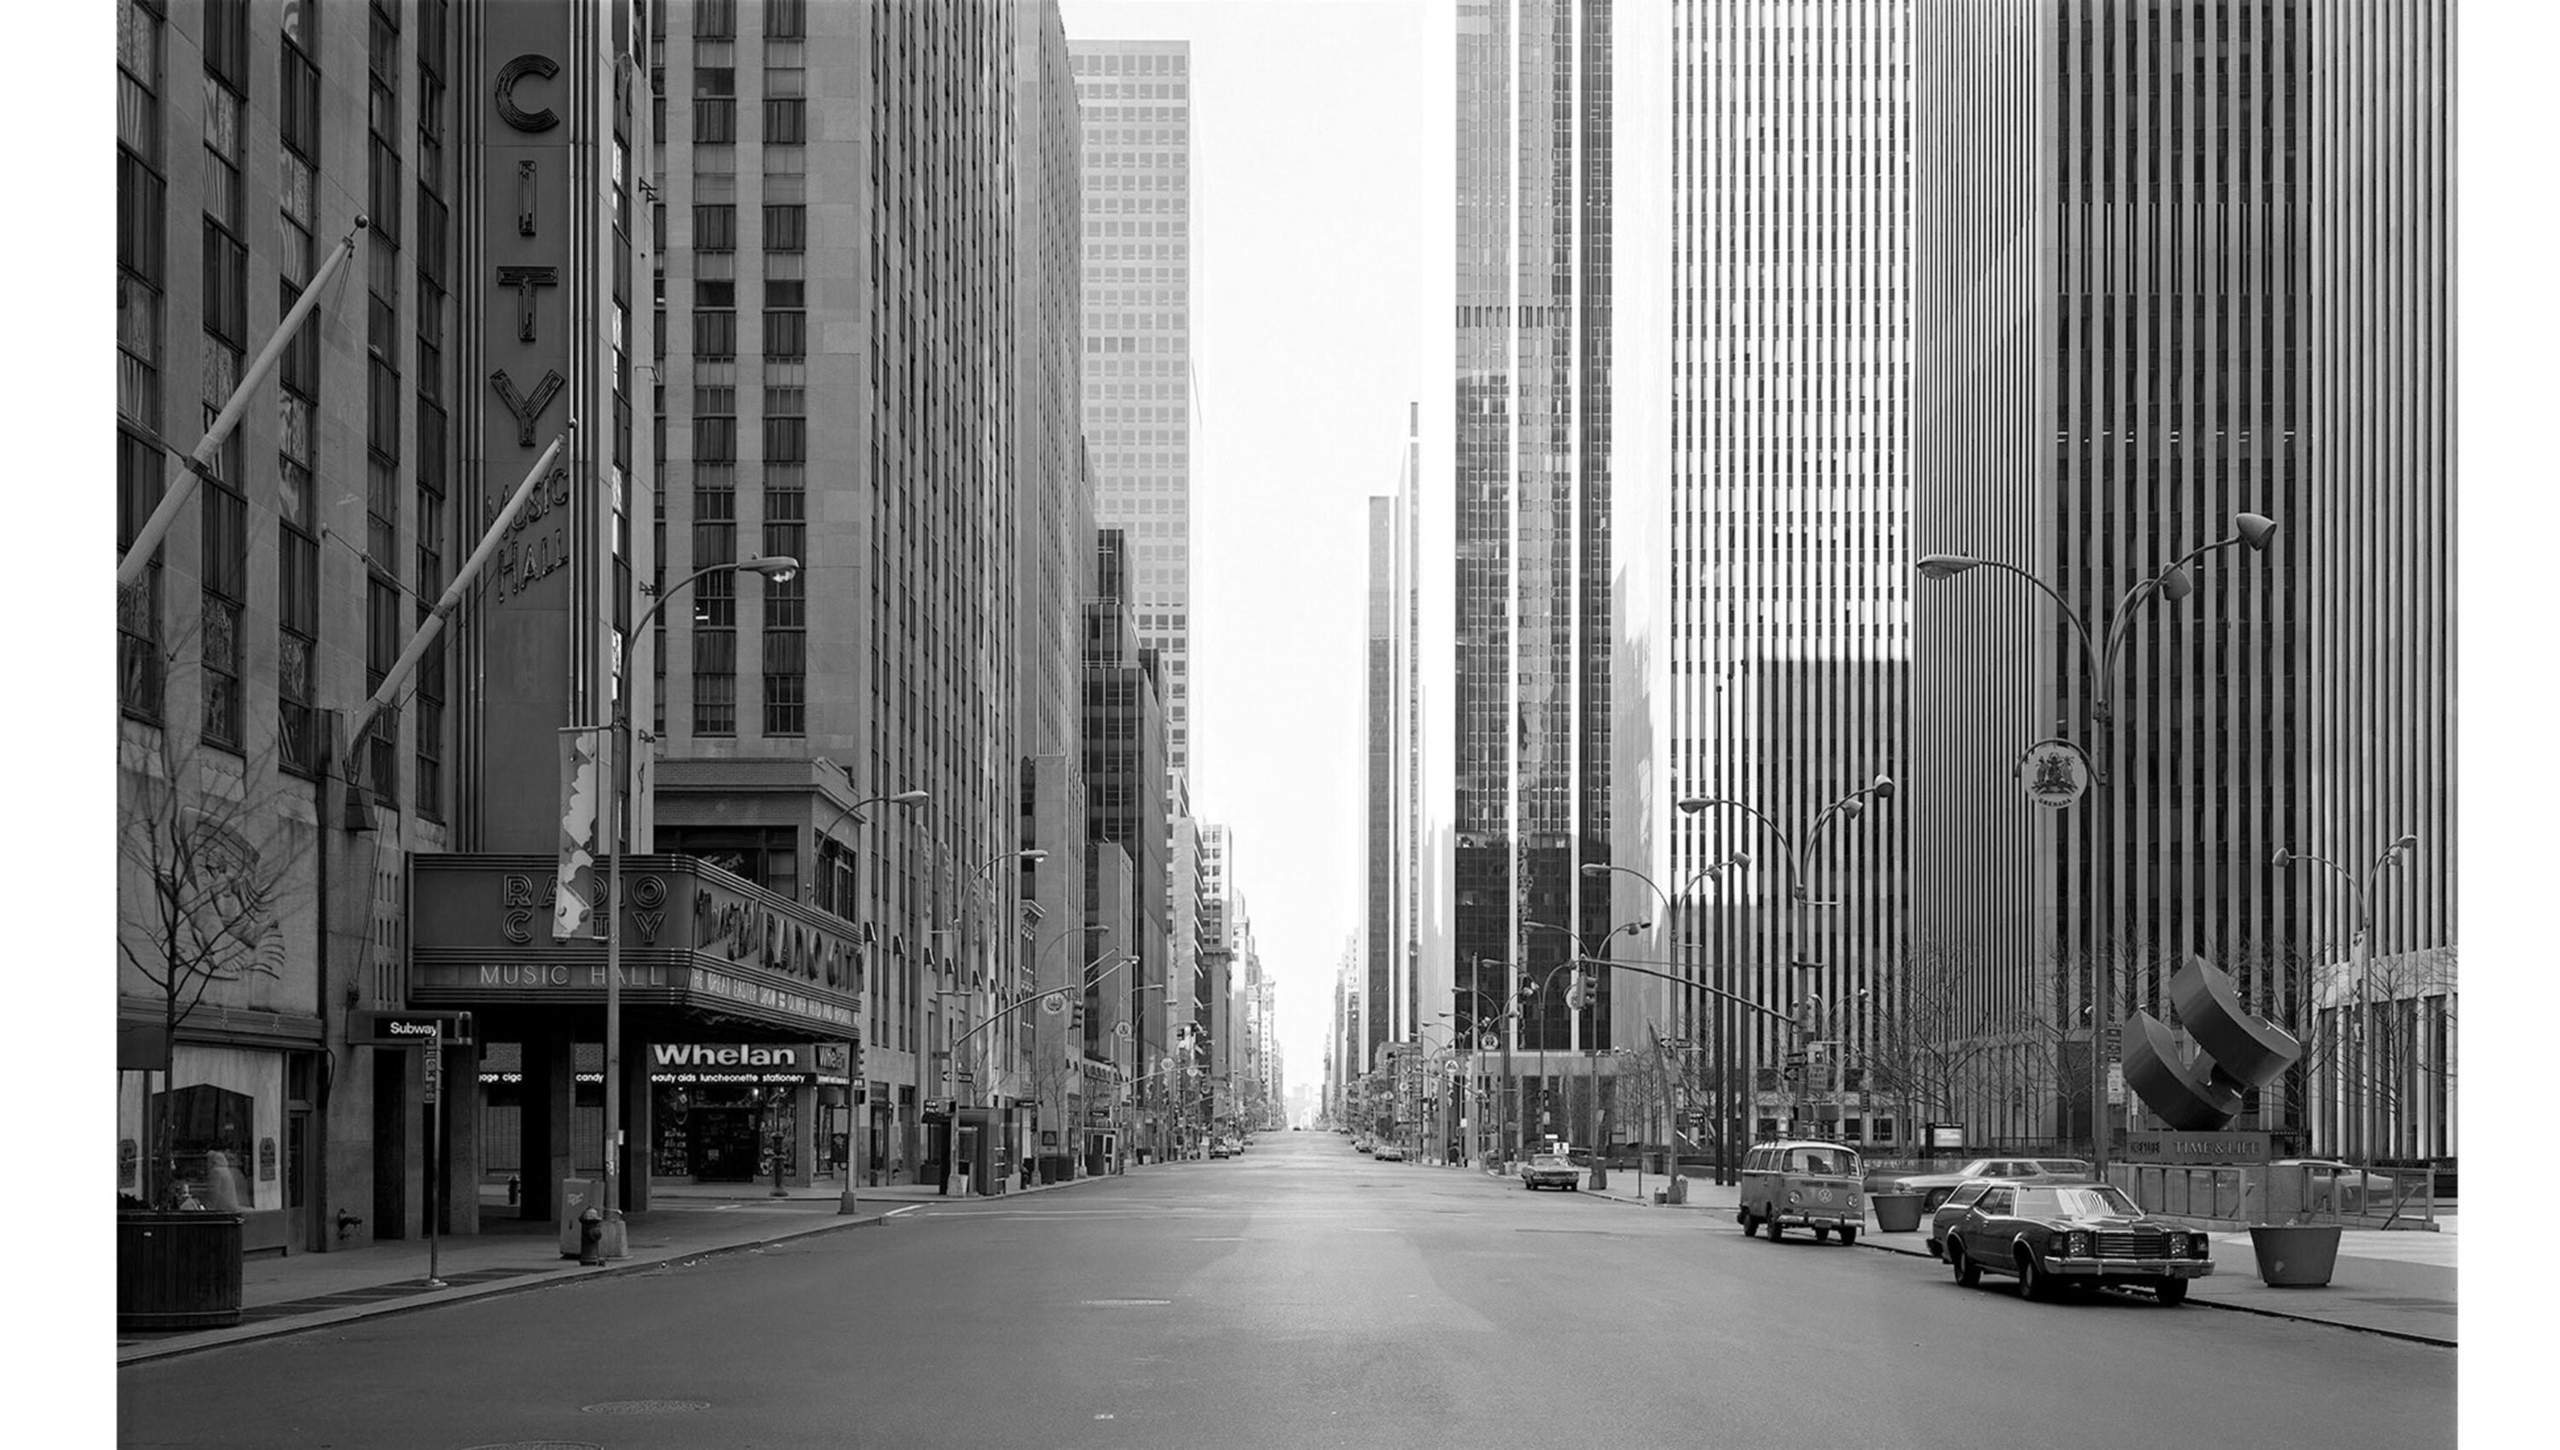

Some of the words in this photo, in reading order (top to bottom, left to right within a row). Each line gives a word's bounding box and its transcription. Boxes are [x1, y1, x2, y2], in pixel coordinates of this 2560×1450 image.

[490, 52, 566, 447] CITY
[498, 529, 568, 604] HALL
[502, 908, 665, 943] CTY
[480, 965, 568, 985] MUSIC
[390, 1021, 437, 1037] Subway
[654, 1044, 796, 1065] Whelan
[576, 1072, 604, 1084] candy
[677, 1072, 697, 1083] aids
[700, 1073, 759, 1083] luncheonette
[762, 1073, 806, 1084] stationery
[2174, 1141, 2210, 1154] TIME
[2214, 1141, 2224, 1154] &
